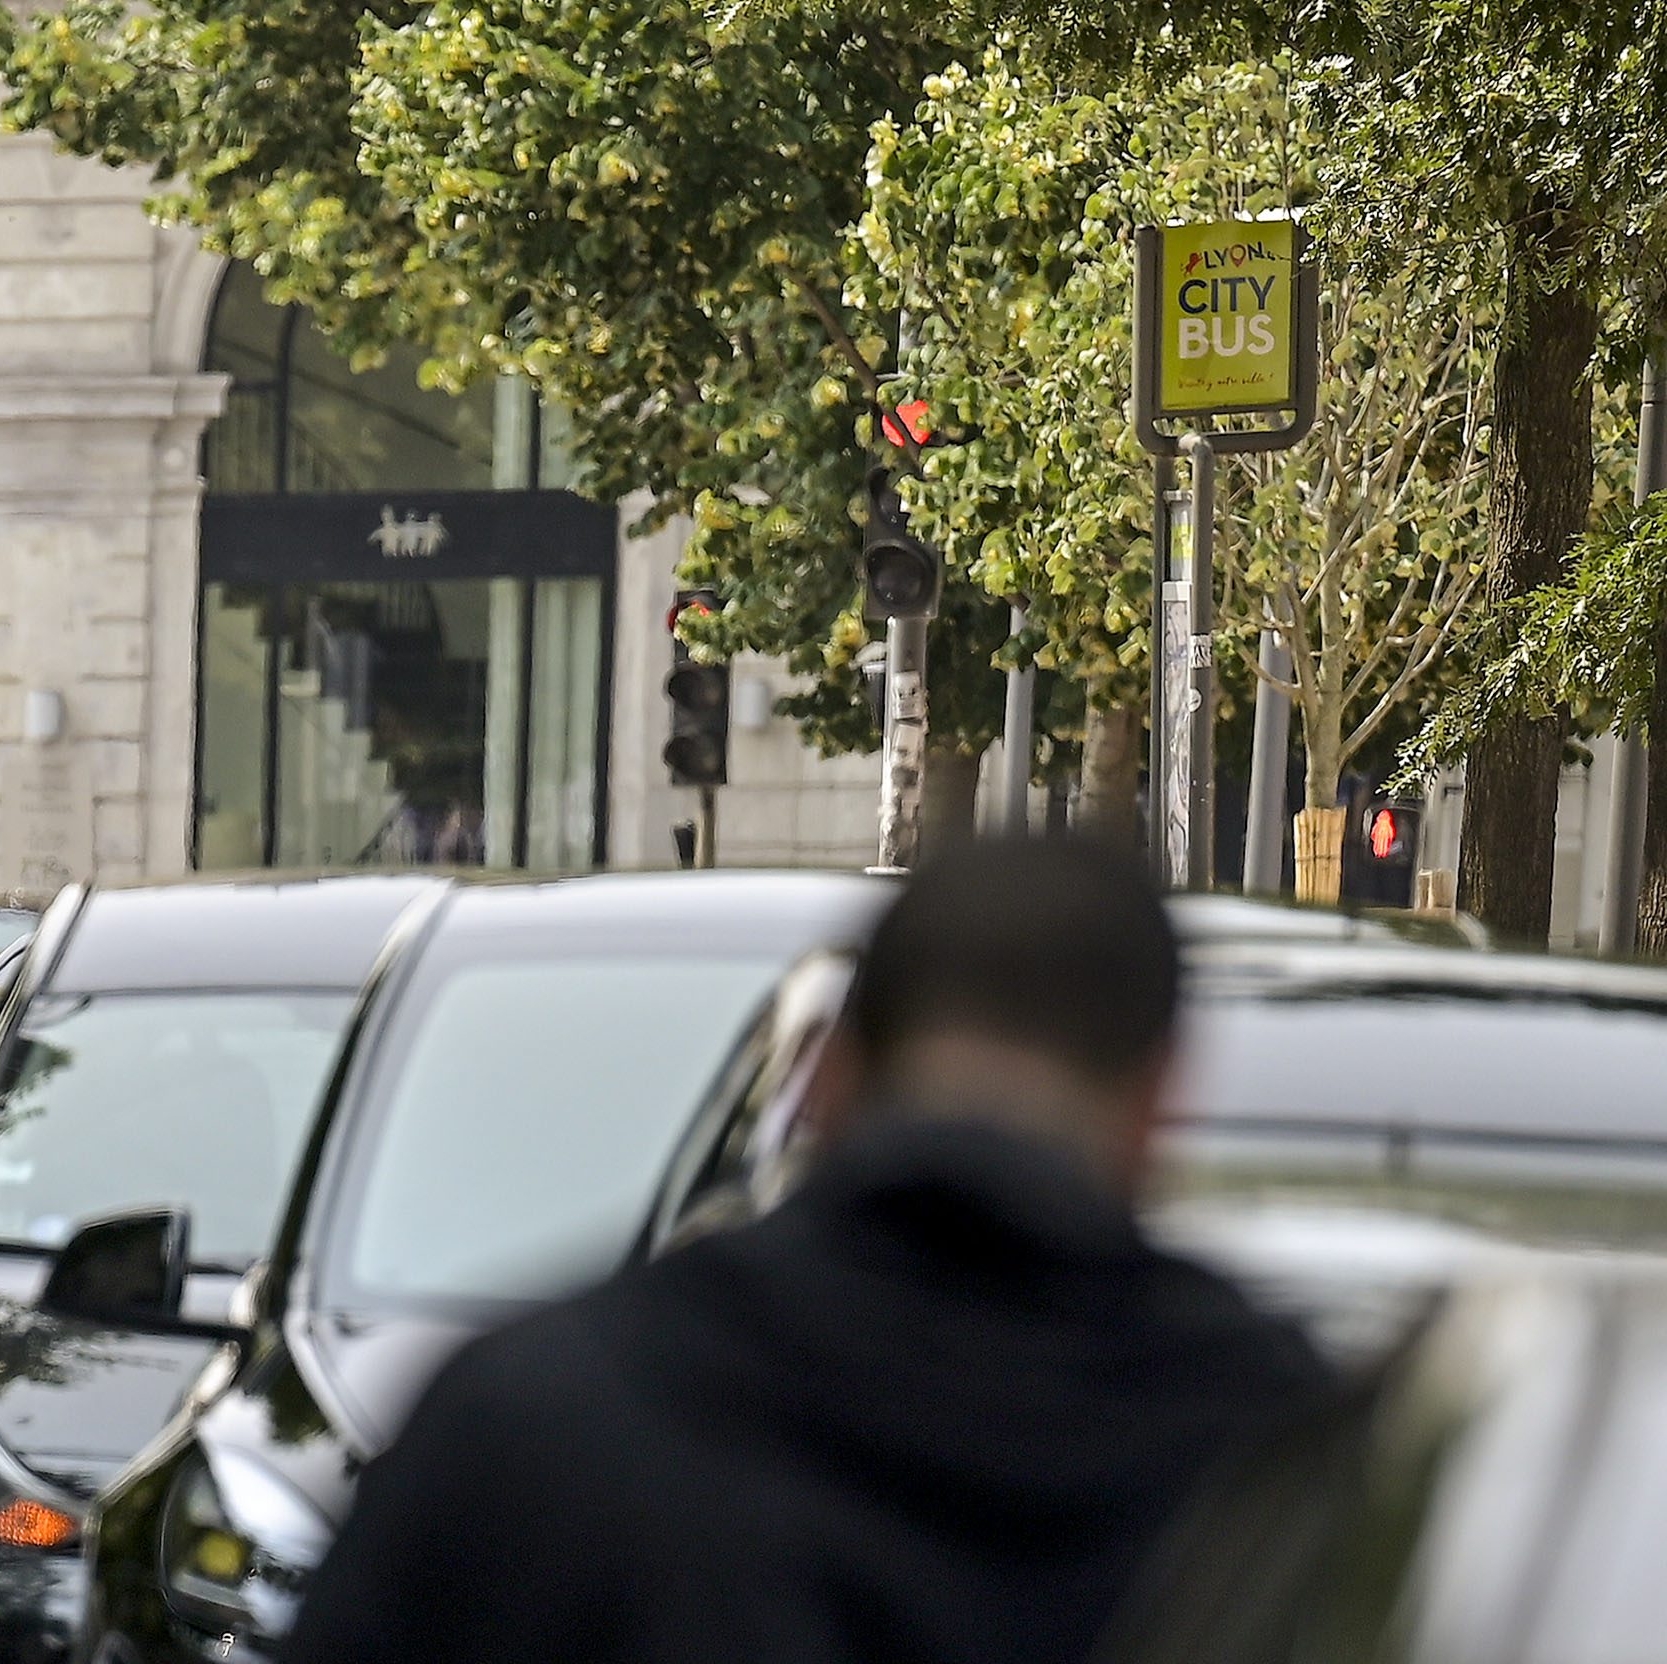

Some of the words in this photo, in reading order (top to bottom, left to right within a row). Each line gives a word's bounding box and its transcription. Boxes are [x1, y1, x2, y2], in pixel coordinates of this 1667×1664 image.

[1204, 241, 1264, 269] LYON
[1178, 275, 1276, 314] CITY
[1178, 314, 1276, 359] BUS
